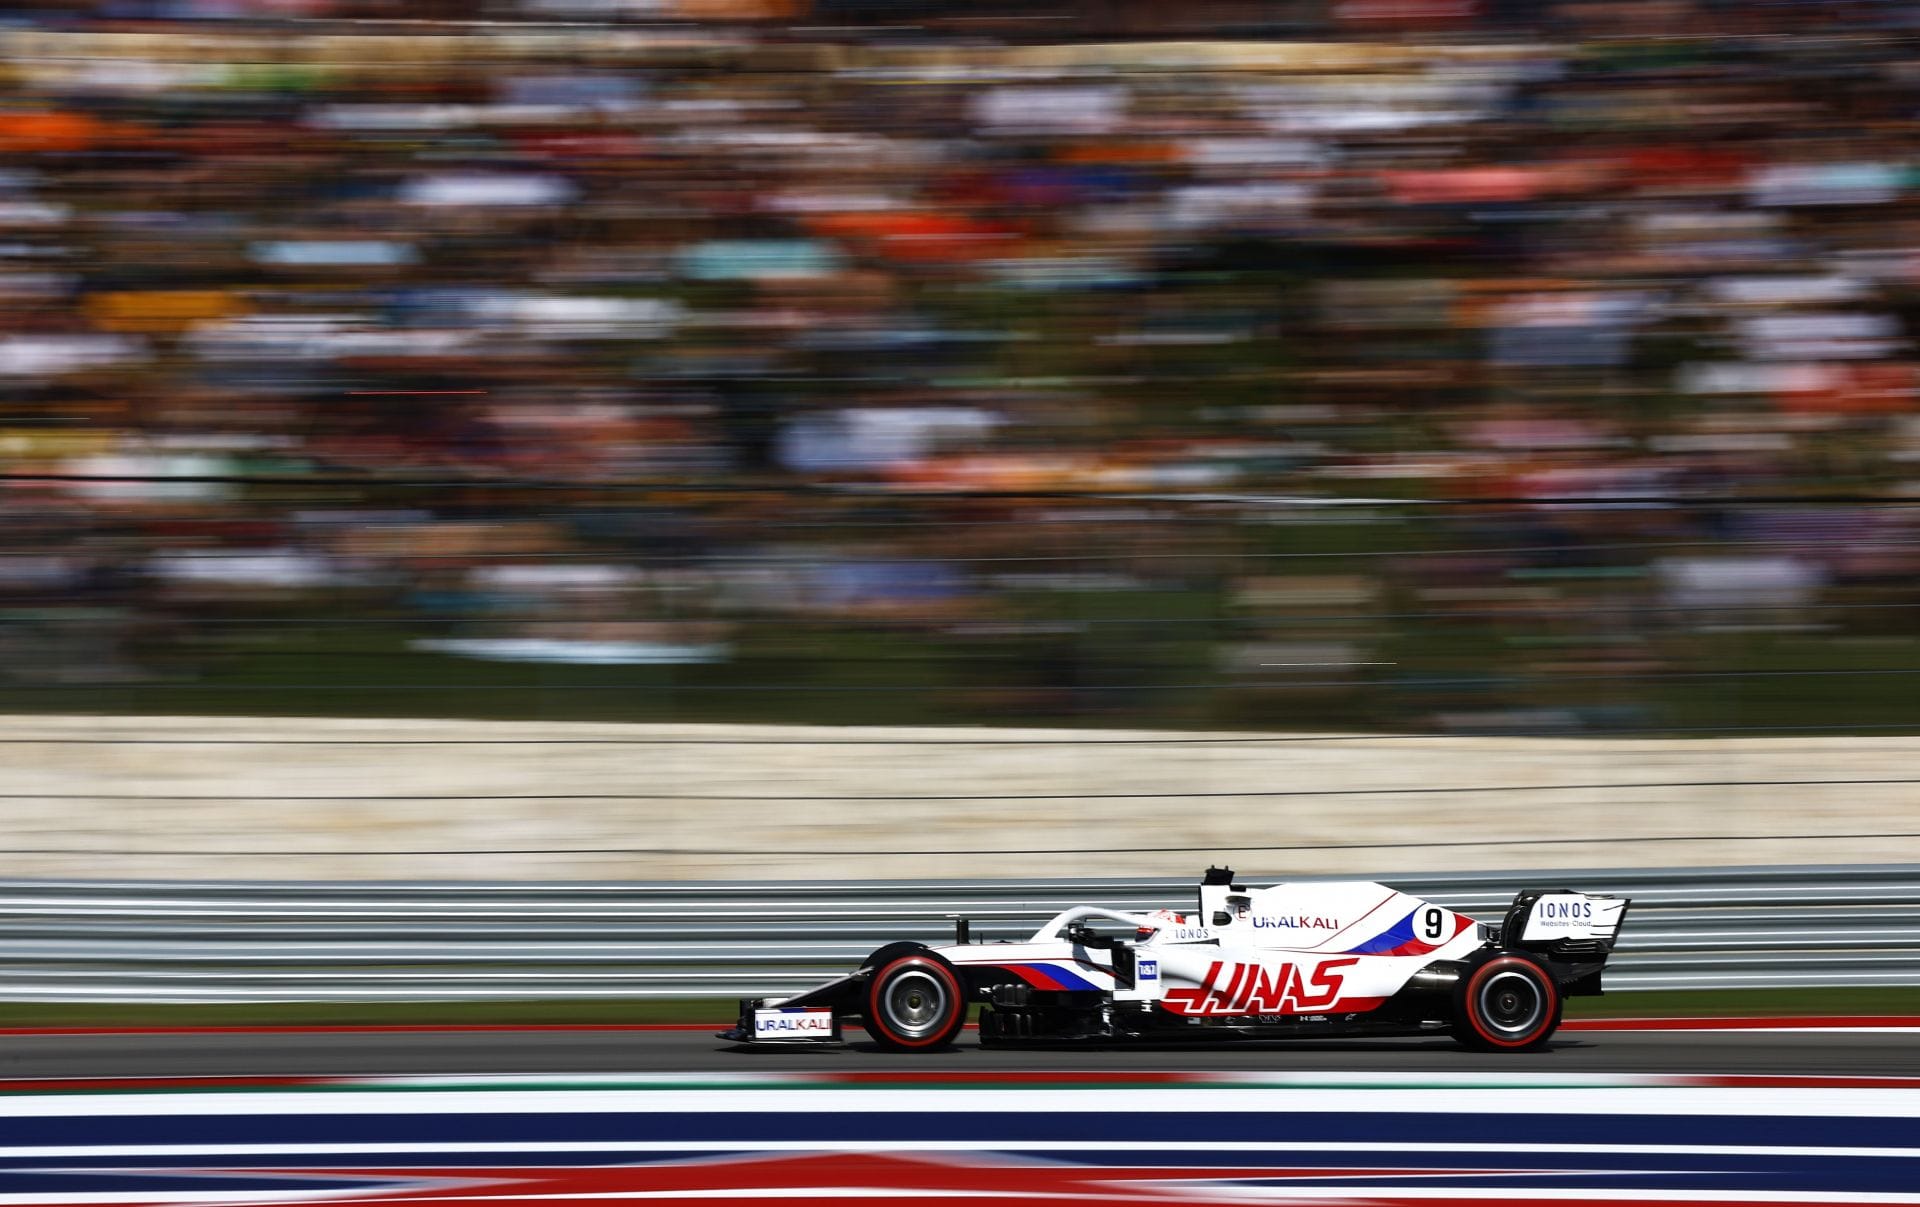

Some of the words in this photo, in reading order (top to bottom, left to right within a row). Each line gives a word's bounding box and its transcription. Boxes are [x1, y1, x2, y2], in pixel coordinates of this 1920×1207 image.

[1540, 902, 1591, 918] IONOS
[1253, 915, 1339, 930] URALKALI
[1425, 908, 1443, 939] 9
[1175, 928, 1209, 939] IONOS
[1163, 957, 1361, 1013] HAAS
[755, 1018, 833, 1032] URALKALI
